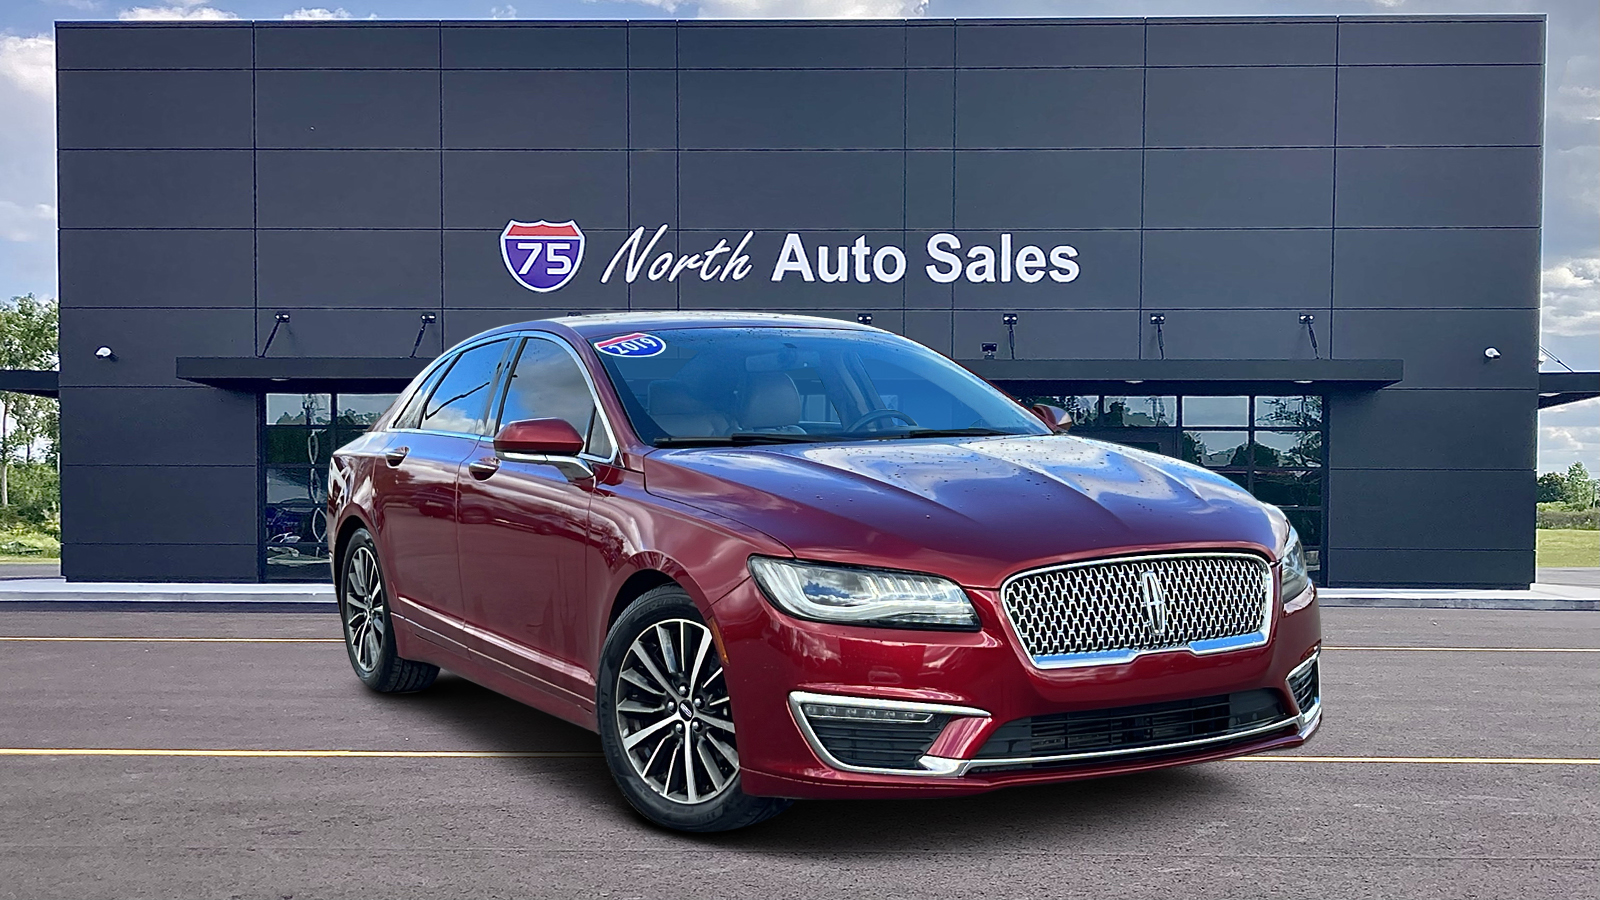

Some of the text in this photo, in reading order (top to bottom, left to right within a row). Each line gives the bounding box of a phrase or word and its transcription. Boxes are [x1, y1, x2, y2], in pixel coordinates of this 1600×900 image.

[517, 225, 1080, 283] 75 North Auto Sales
[608, 337, 658, 355] 2019
